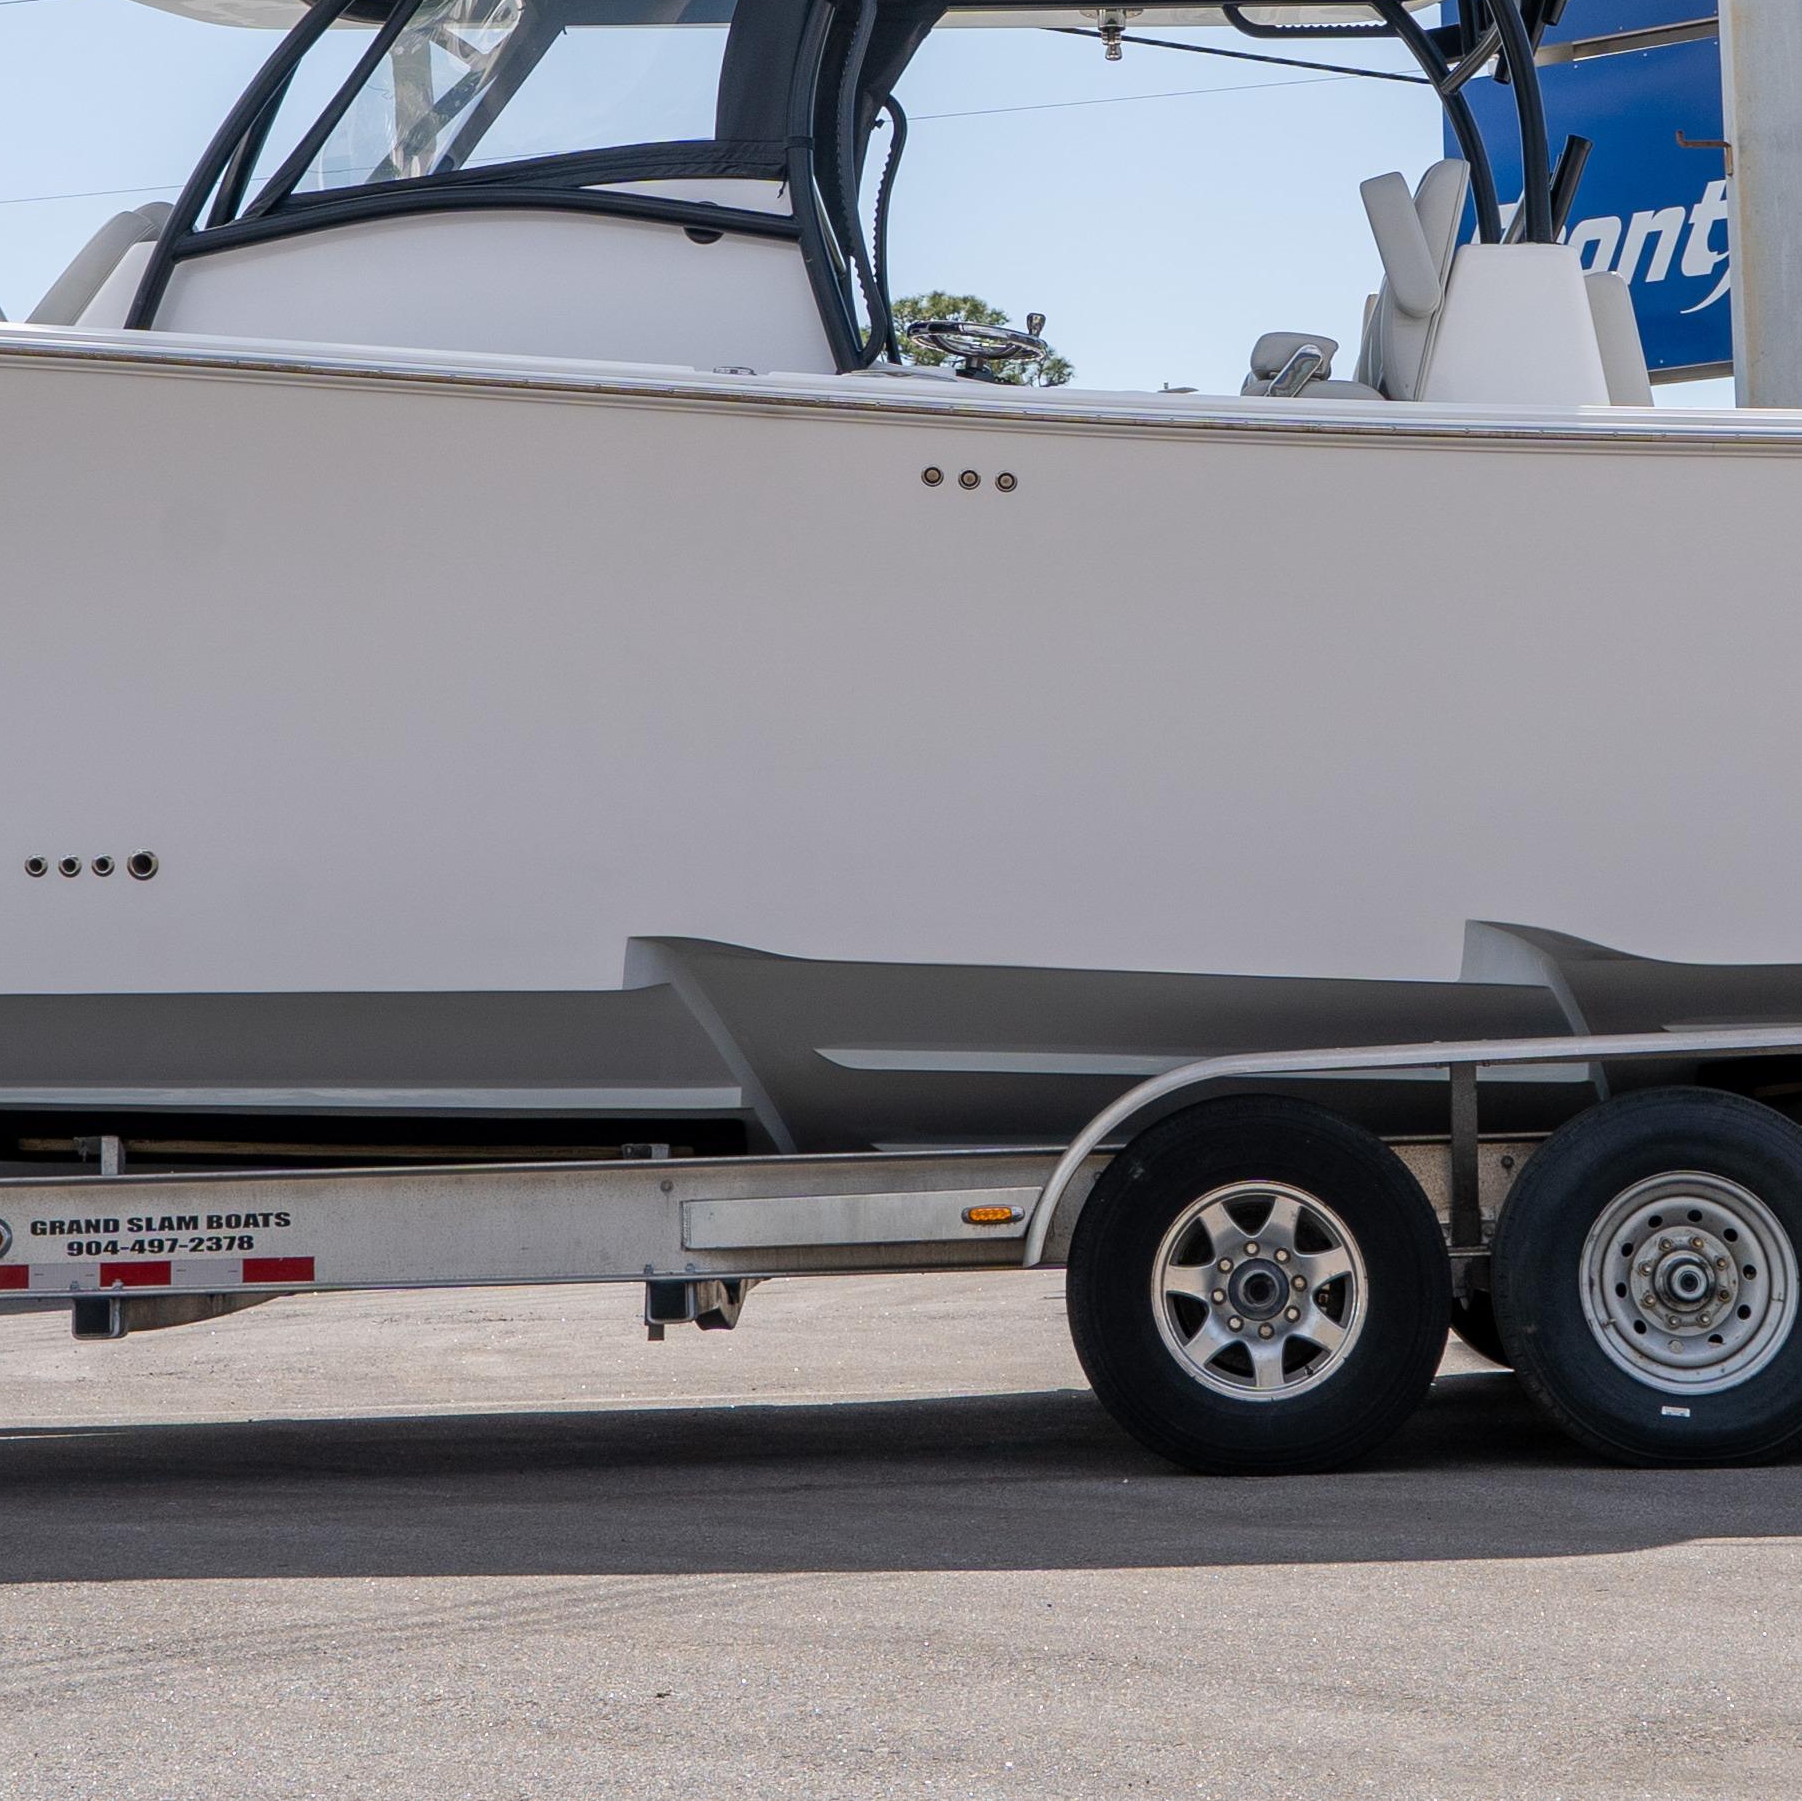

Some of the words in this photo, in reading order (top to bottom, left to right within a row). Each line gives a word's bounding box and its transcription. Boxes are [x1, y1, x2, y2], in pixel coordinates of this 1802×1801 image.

[30, 1218, 120, 1236] GRAND
[127, 1215, 198, 1232] SLAM
[206, 1211, 291, 1230] BOATS
[66, 1235, 255, 1257] 904-497-2378
